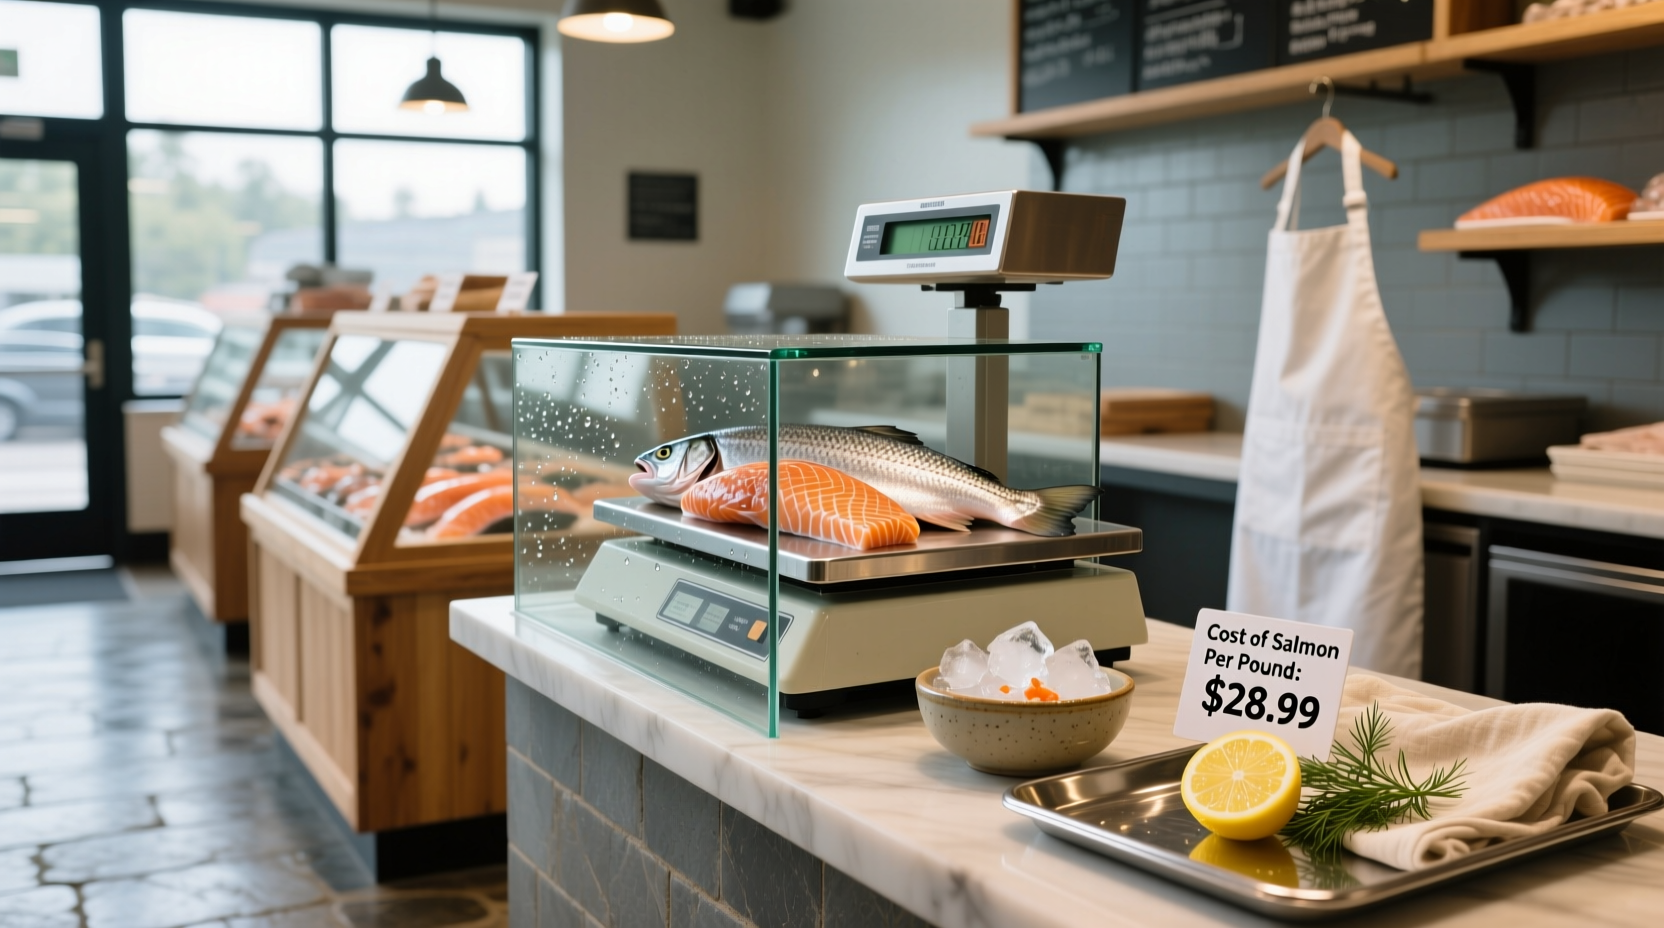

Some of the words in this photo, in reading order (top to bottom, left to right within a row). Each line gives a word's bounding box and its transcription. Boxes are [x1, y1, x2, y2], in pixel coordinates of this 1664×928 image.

[1207, 623, 1247, 645] Cost
[1250, 630, 1270, 648] of
[1272, 632, 1340, 660] Salmon
[1204, 648, 1235, 669] Per
[1238, 653, 1302, 682] Pound:
[1202, 674, 1320, 729] $28.99
